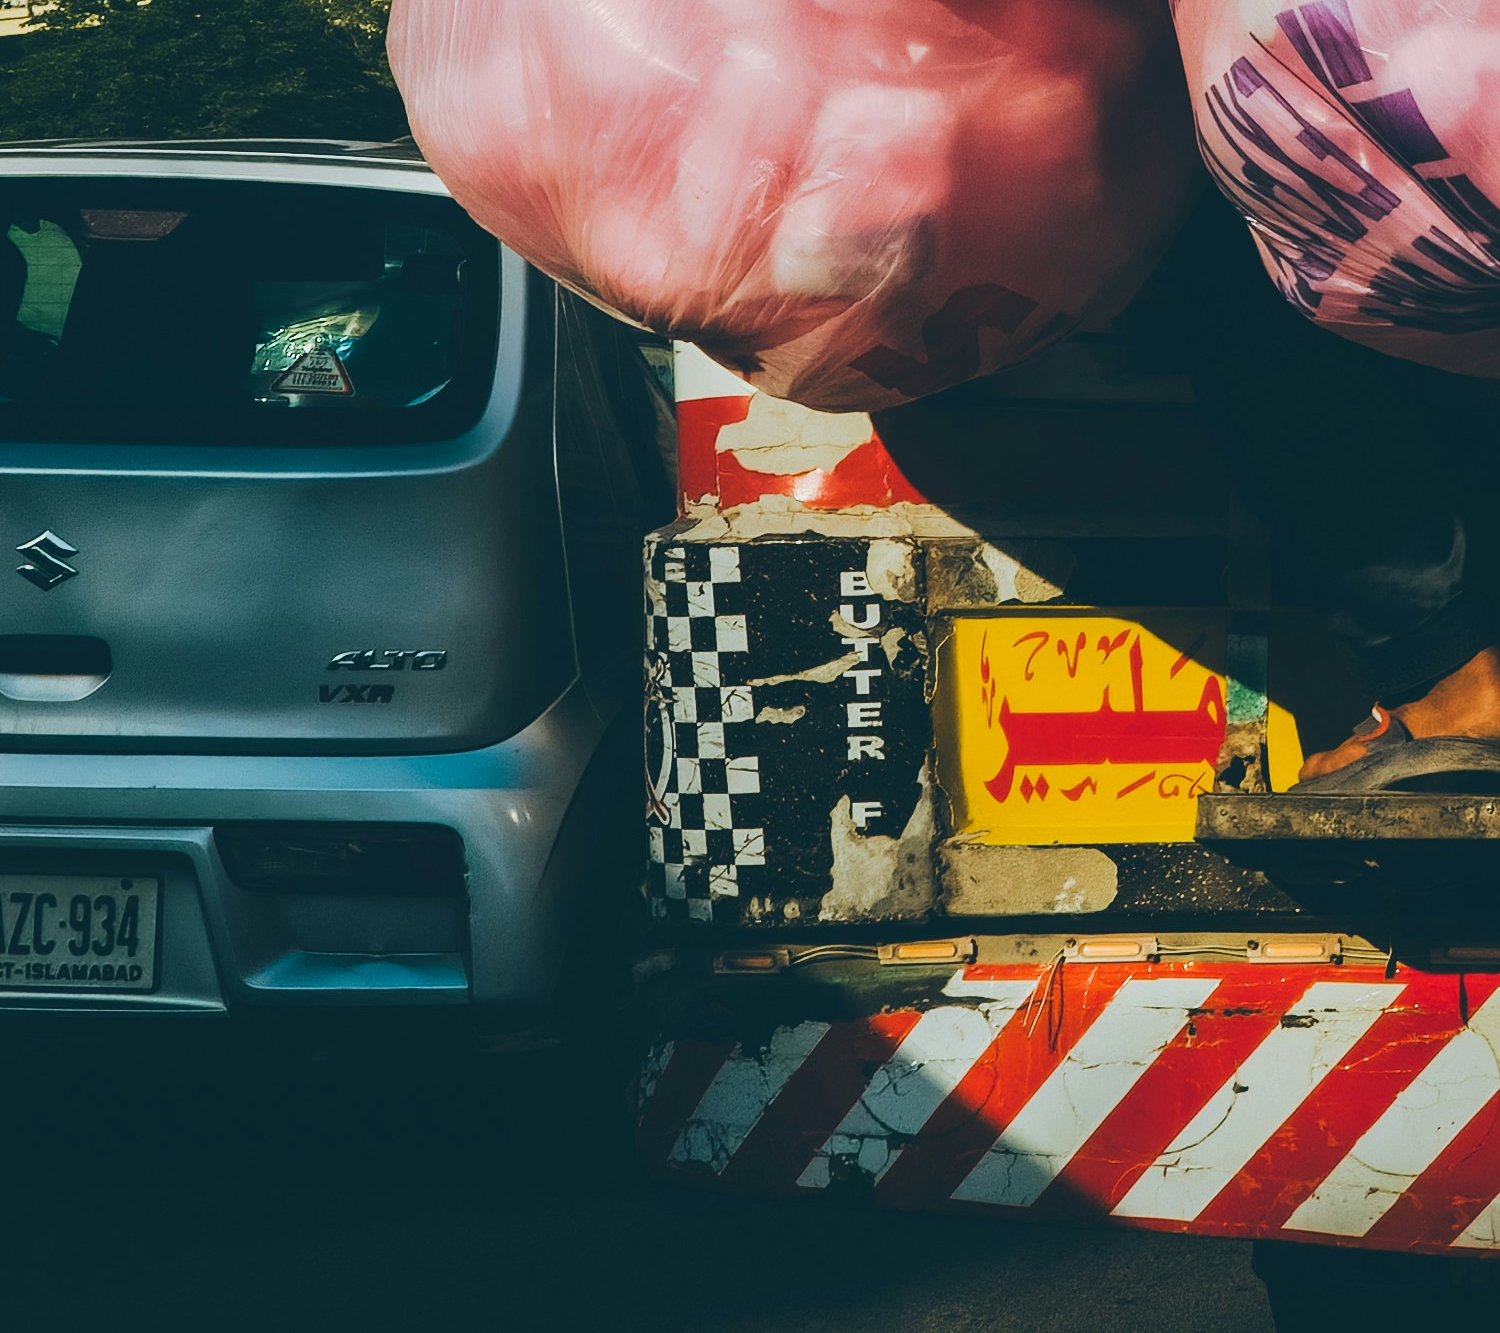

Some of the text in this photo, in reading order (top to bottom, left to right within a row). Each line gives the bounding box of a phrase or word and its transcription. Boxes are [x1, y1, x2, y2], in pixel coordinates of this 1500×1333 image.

[326, 647, 448, 671] ALTO
[838, 570, 886, 762] BUTTER
[318, 684, 395, 704] VXR
